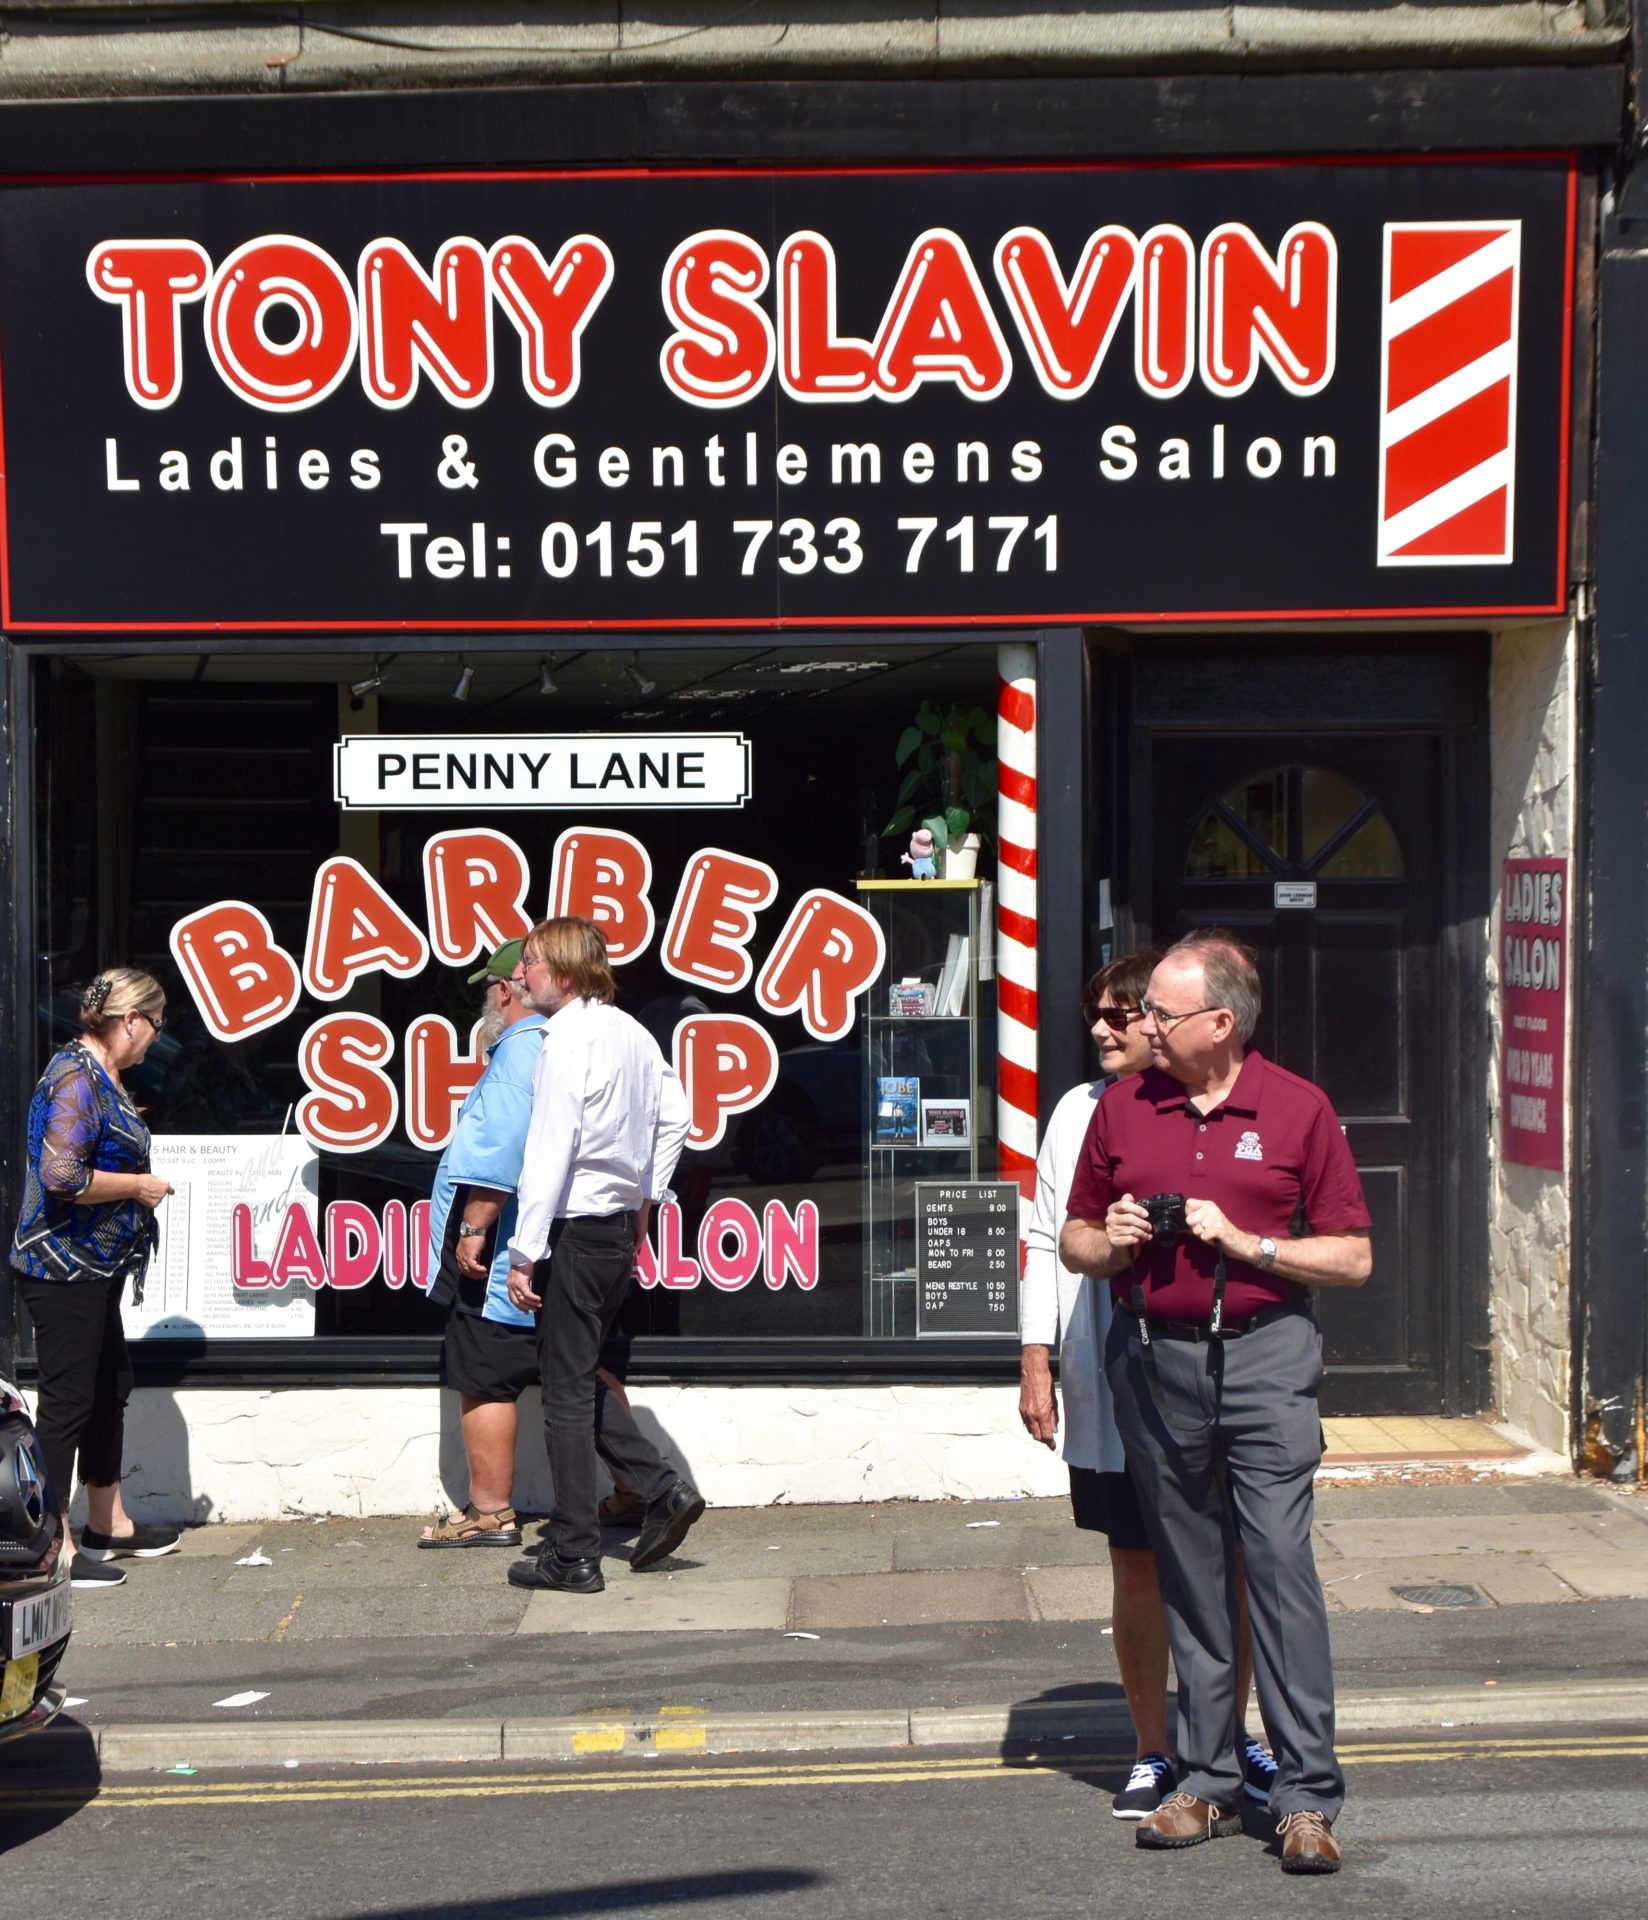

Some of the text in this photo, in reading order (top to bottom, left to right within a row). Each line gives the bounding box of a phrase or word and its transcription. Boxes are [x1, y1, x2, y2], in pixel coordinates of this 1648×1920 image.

[86, 221, 1338, 413] TONY SLAVIN
[106, 424, 1335, 491] Ladies & Gentlemens Salon
[380, 515, 1057, 579] Tel: 0151 733 7171
[379, 753, 705, 789] PENNY LANE
[1504, 872, 1562, 927] LADIES
[169, 826, 886, 1042] BARBER
[1504, 933, 1560, 991] SALON
[295, 1011, 779, 1153] SHP
[162, 1146, 186, 1154] HAIR
[190, 1146, 197, 1154] &
[200, 1146, 237, 1154] BEAUTY
[1236, 1143, 1262, 1154] PGA
[940, 1190, 998, 1199] PRICE LIST
[926, 1204, 954, 1213] GENTS
[927, 1218, 948, 1226] BOYS
[927, 1227, 953, 1236] UNDER
[927, 1239, 951, 1248] OAPS
[928, 1249, 945, 1257] MON
[949, 1249, 959, 1257] TO
[962, 1249, 974, 1257] FRI
[927, 1260, 952, 1269] BEARD
[926, 1282, 945, 1290] MENS
[948, 1282, 978, 1290] RESTYLE
[925, 1292, 948, 1300] BOYS
[925, 1301, 945, 1310] OAP
